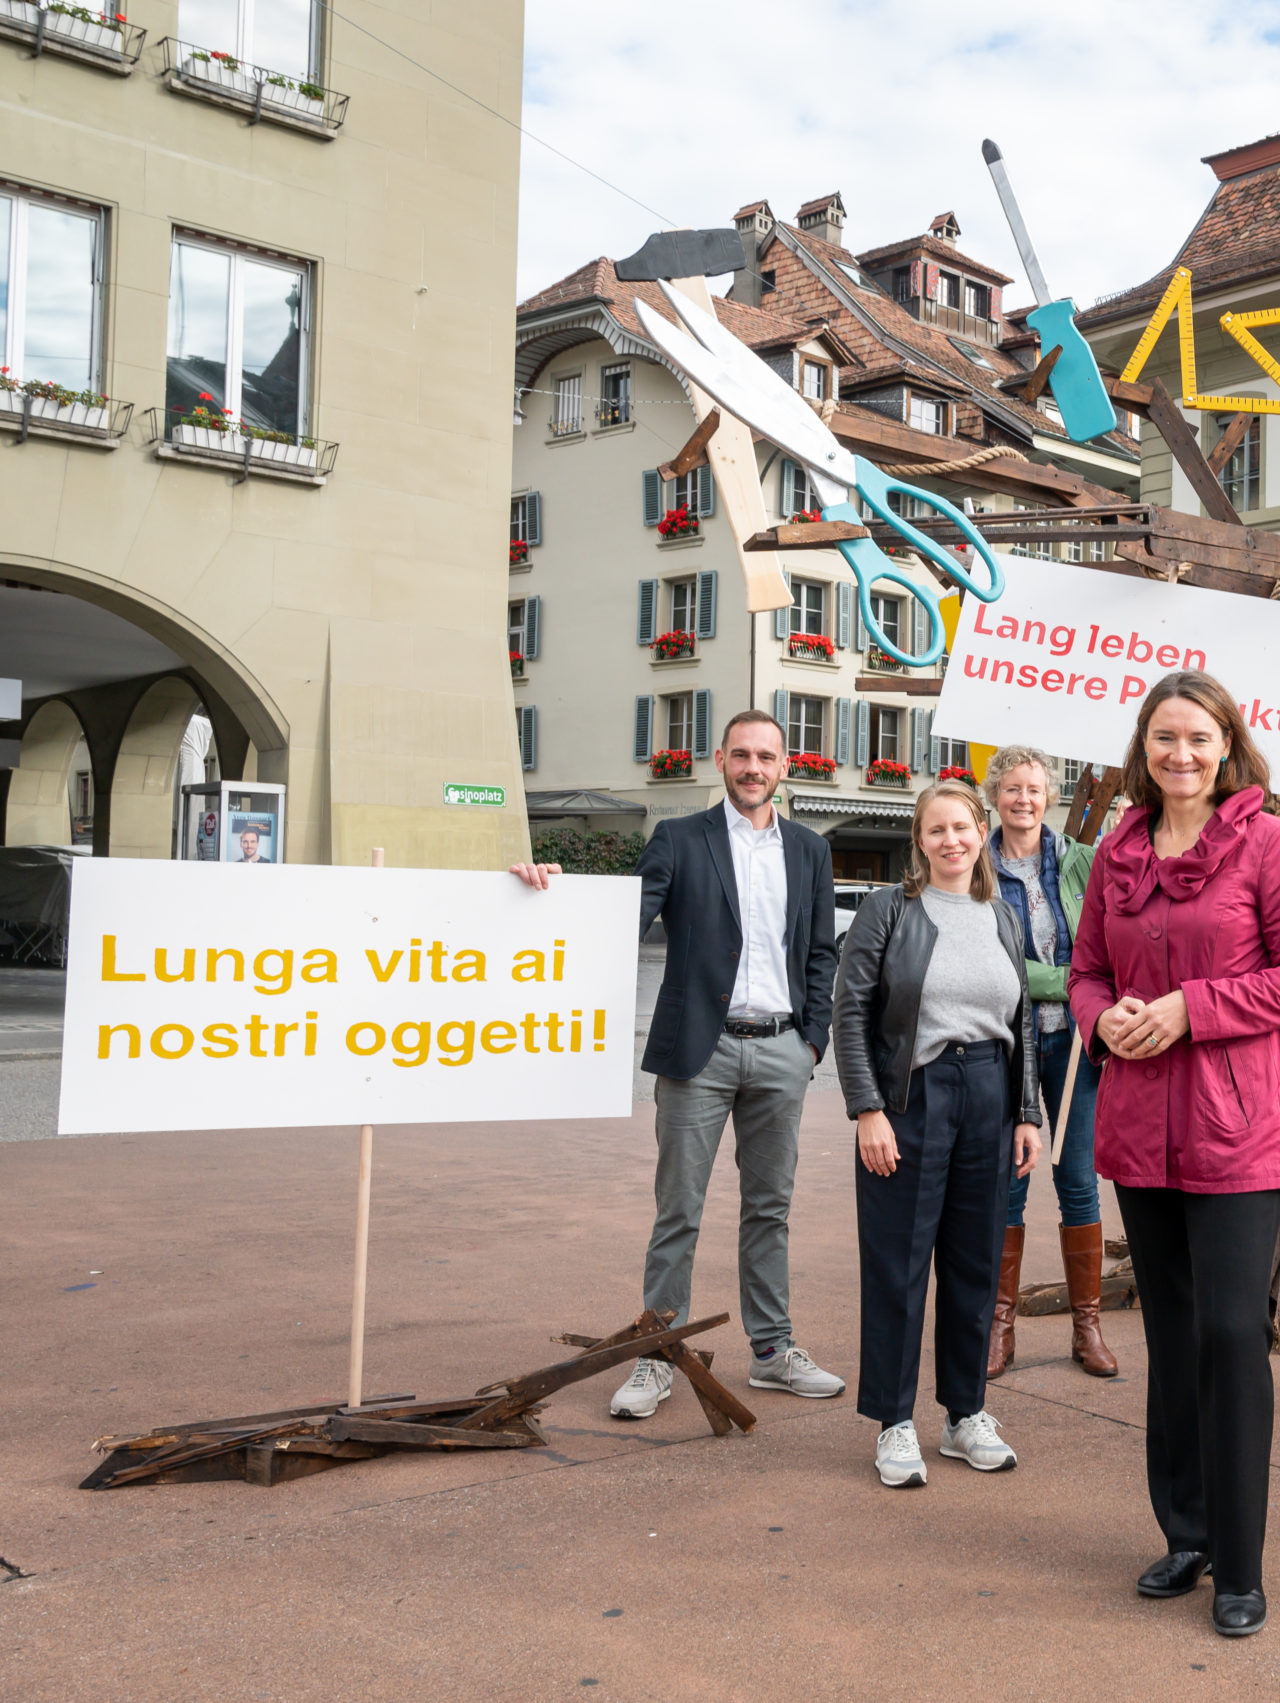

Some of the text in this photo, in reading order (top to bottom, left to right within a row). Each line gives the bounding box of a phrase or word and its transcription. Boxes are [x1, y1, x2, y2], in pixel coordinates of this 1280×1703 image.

[973, 604, 1207, 672] Lang leben
[965, 655, 1108, 701] unsere
[101, 935, 566, 995] Lunga vita ai
[98, 1009, 607, 1068] nostri oggetti!
